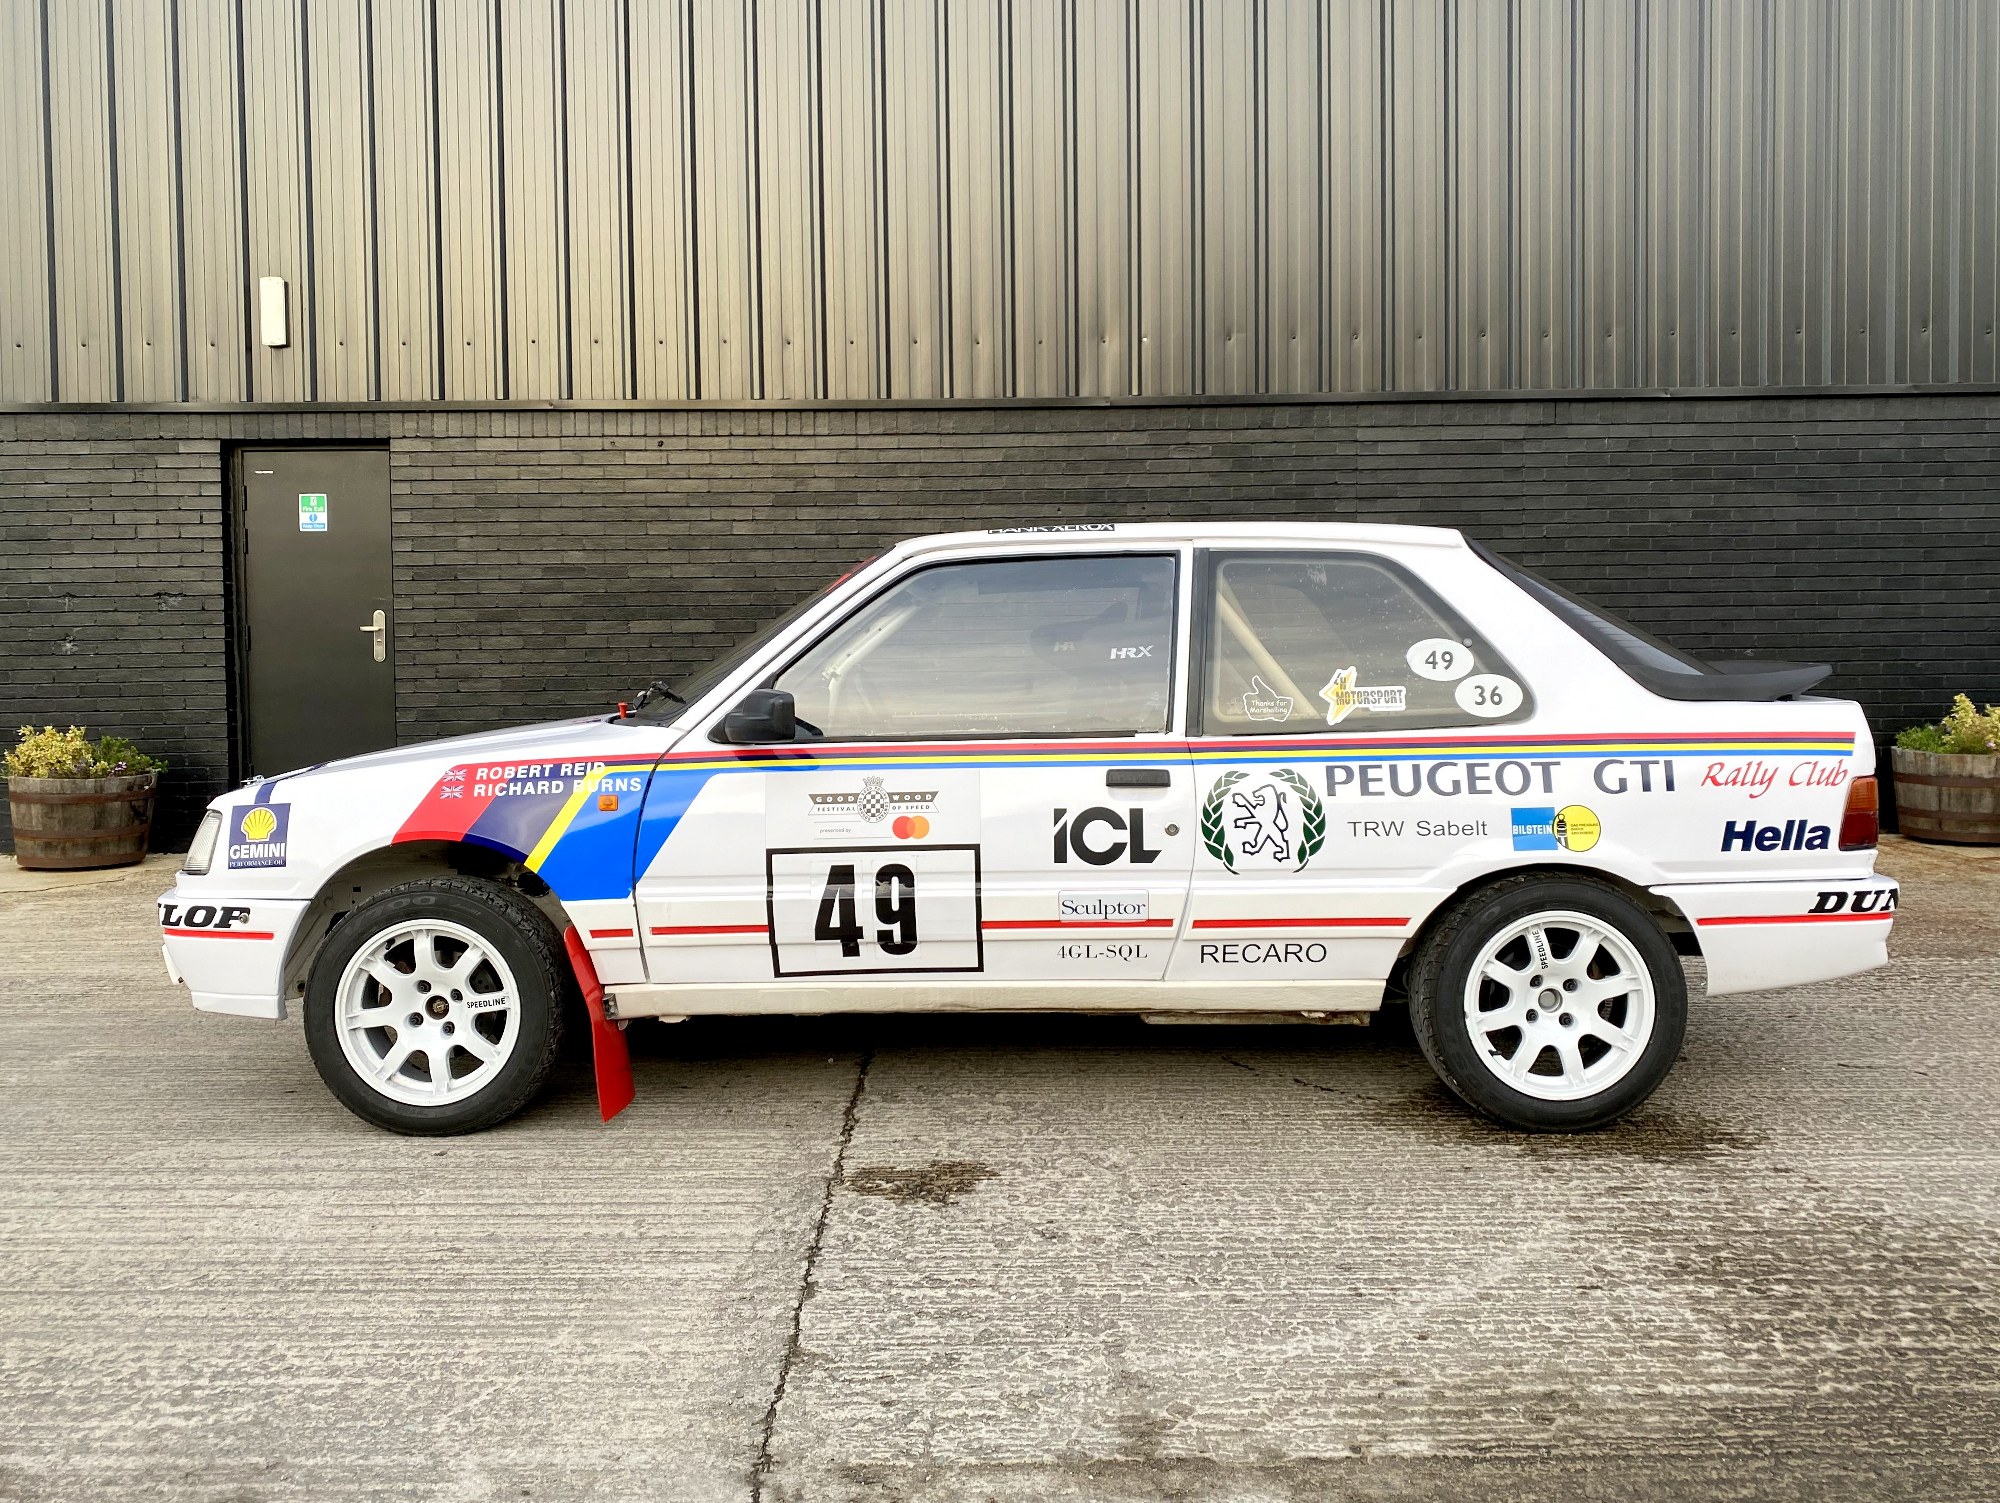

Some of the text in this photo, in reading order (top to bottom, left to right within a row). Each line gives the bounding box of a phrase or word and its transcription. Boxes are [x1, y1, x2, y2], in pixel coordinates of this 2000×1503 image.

[1110, 645, 1154, 660] HRX
[1425, 650, 1454, 670] 49
[1335, 689, 1403, 706] MOTORSPORT
[1474, 685, 1503, 706] 36
[476, 761, 606, 781] ROBERT REID
[1325, 759, 1676, 797] PEUGEOT GTI
[1700, 758, 1849, 799] Rally Club
[473, 777, 642, 798] RICHARD BURNS
[817, 805, 856, 813] FESTIVAL
[1053, 806, 1162, 866] ICL
[1347, 819, 1488, 837] TRW Sabelt
[1512, 824, 1553, 835] BILSTEIN
[1721, 819, 1831, 852] Hella
[229, 842, 286, 860] GEMINI
[229, 859, 273, 868] PERFORMANCE
[815, 863, 918, 958] 49
[1061, 899, 1146, 920] Sculptor
[1056, 944, 1148, 960] 4GL-SQL
[1200, 943, 1328, 964] RECARO
[1532, 929, 1549, 970] SPEEDLINE
[466, 997, 507, 1009] SPEEDLINE
